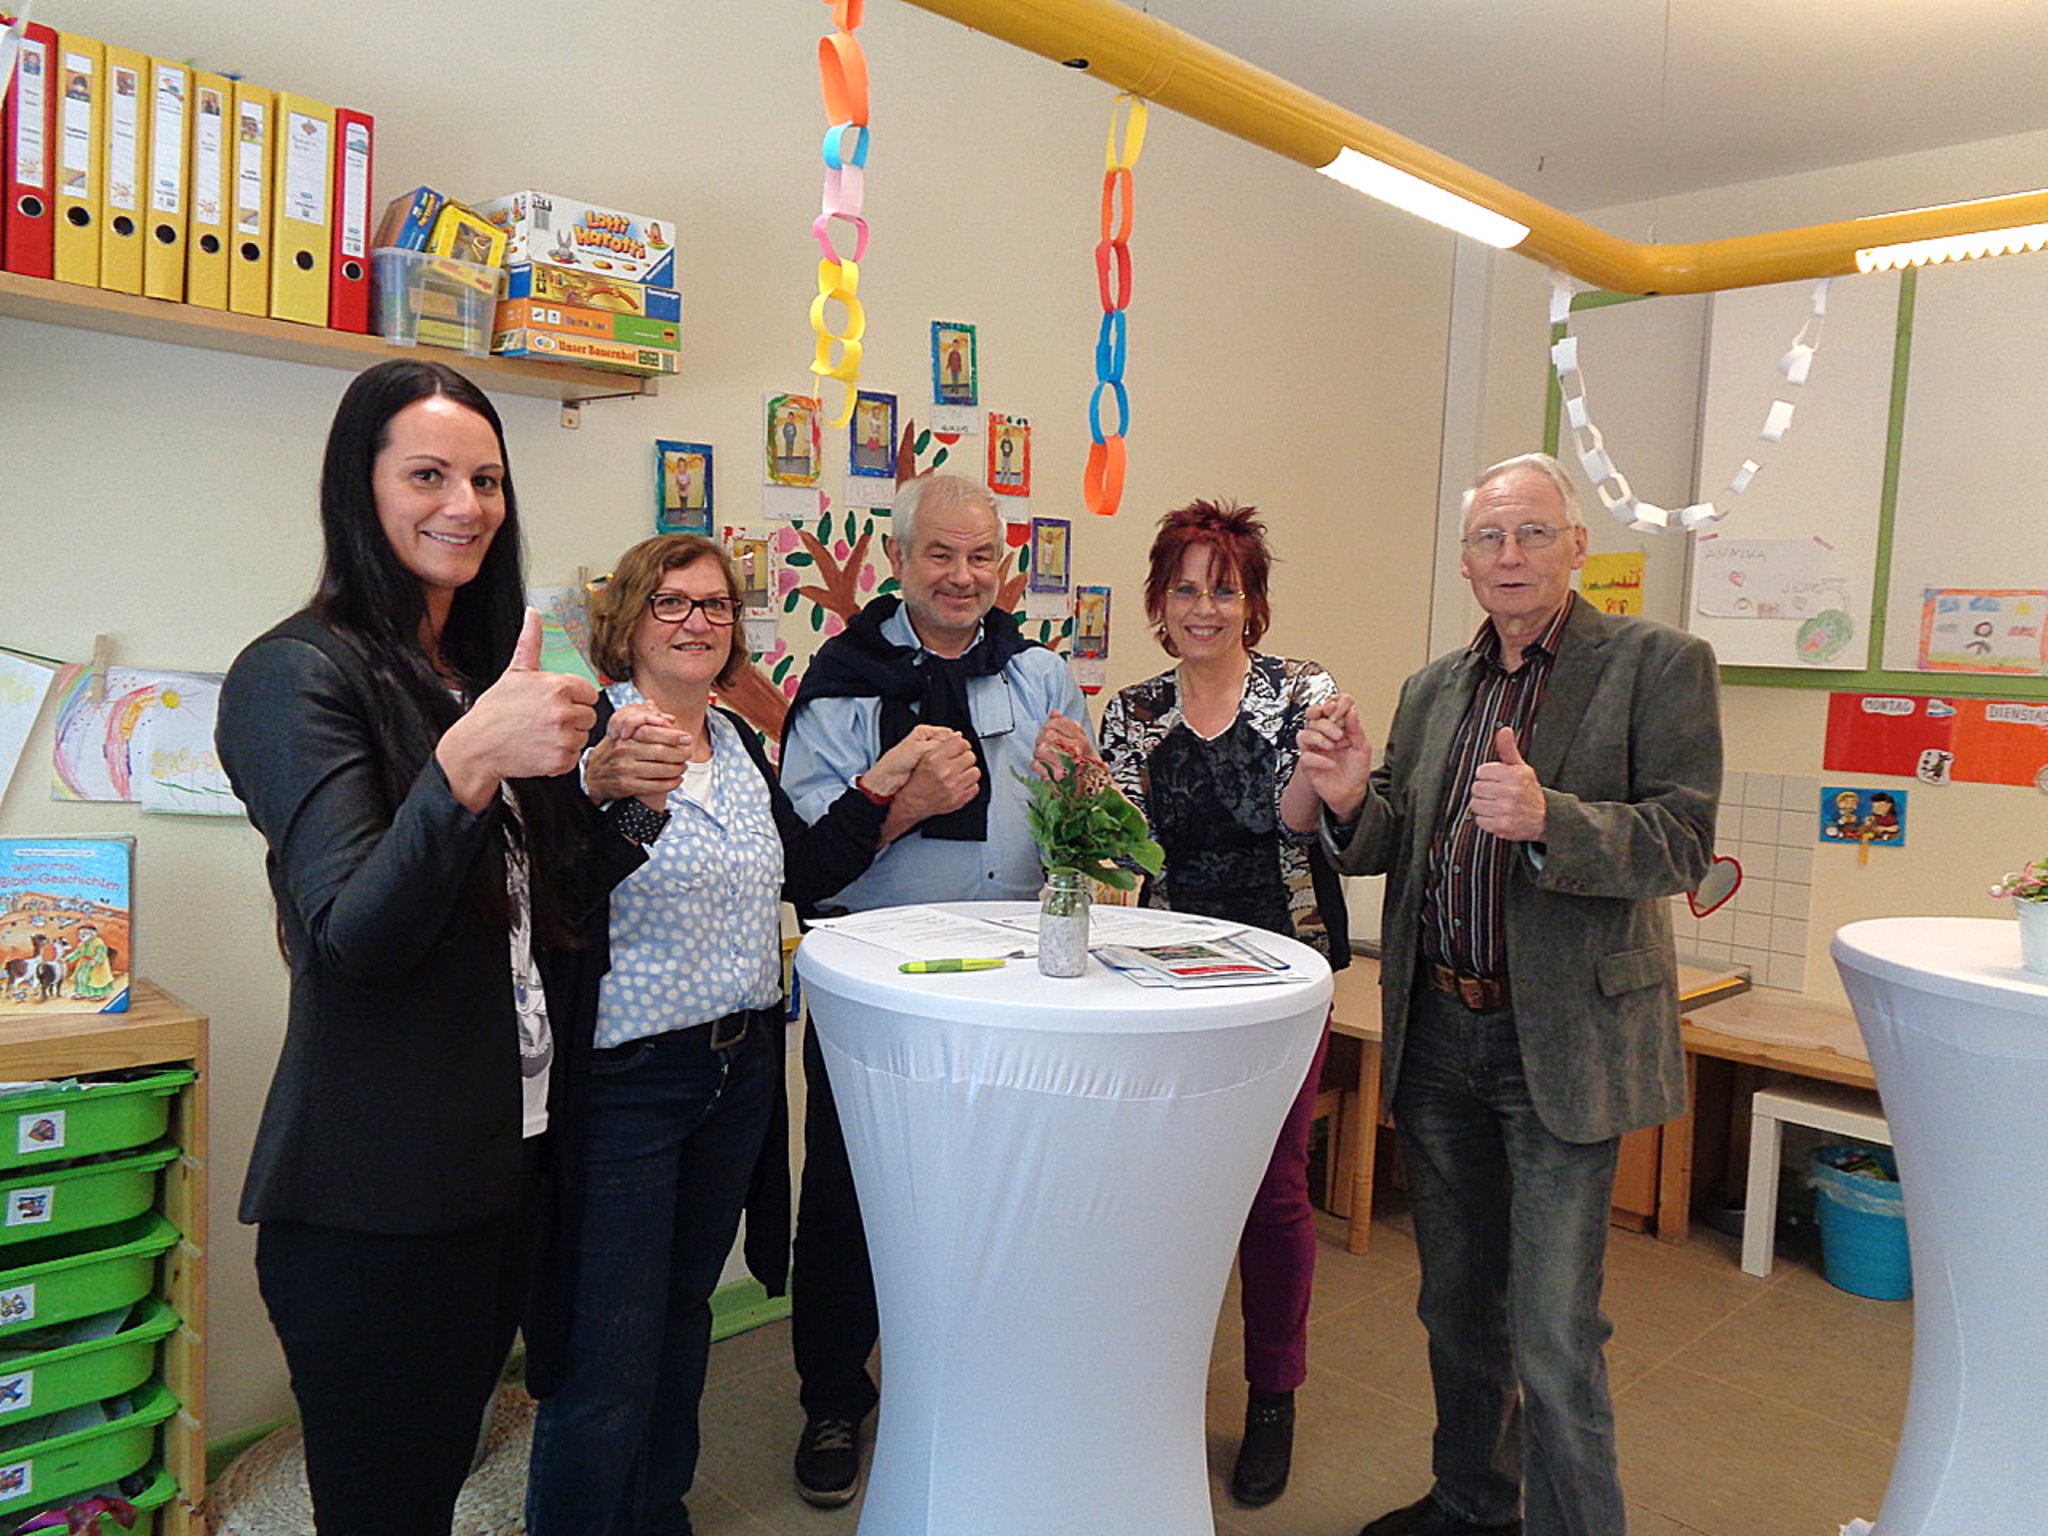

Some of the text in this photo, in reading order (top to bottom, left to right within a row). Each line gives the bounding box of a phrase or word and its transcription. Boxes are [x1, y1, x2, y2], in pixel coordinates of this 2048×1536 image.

[585, 210, 631, 235] Lotti
[573, 224, 646, 260] Karotti
[558, 340, 587, 355] Unser
[1865, 700, 1911, 713] MONTAG
